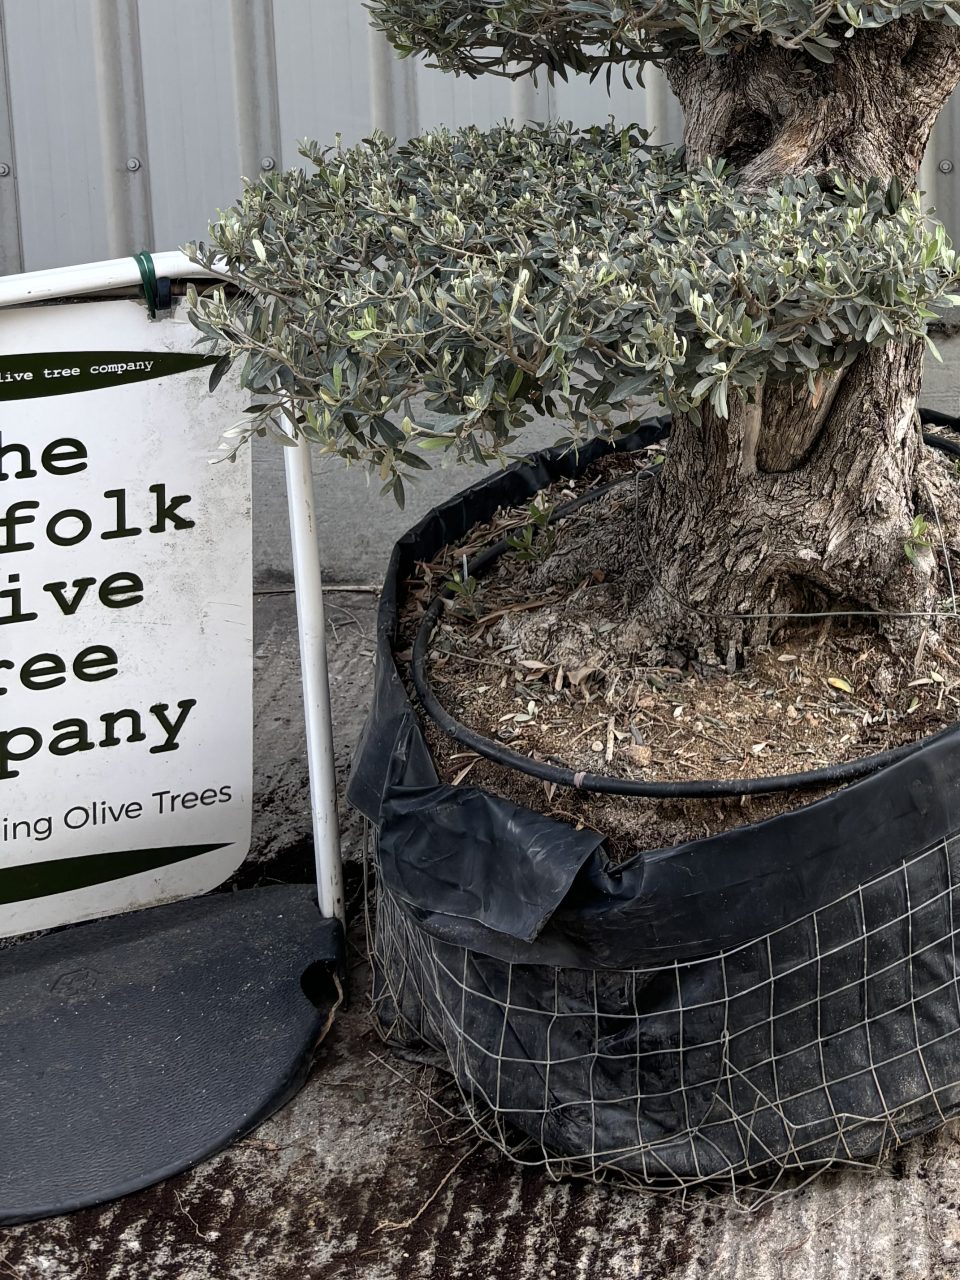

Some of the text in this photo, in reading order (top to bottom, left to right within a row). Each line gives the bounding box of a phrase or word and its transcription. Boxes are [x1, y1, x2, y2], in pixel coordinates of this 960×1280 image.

[43, 368, 81, 378] tree
[90, 361, 154, 374] company
[0, 431, 88, 482] he
[0, 483, 196, 554] folk
[0, 571, 144, 624] ive
[0, 698, 197, 780] pany
[3, 785, 232, 841] ing Olive Trees
